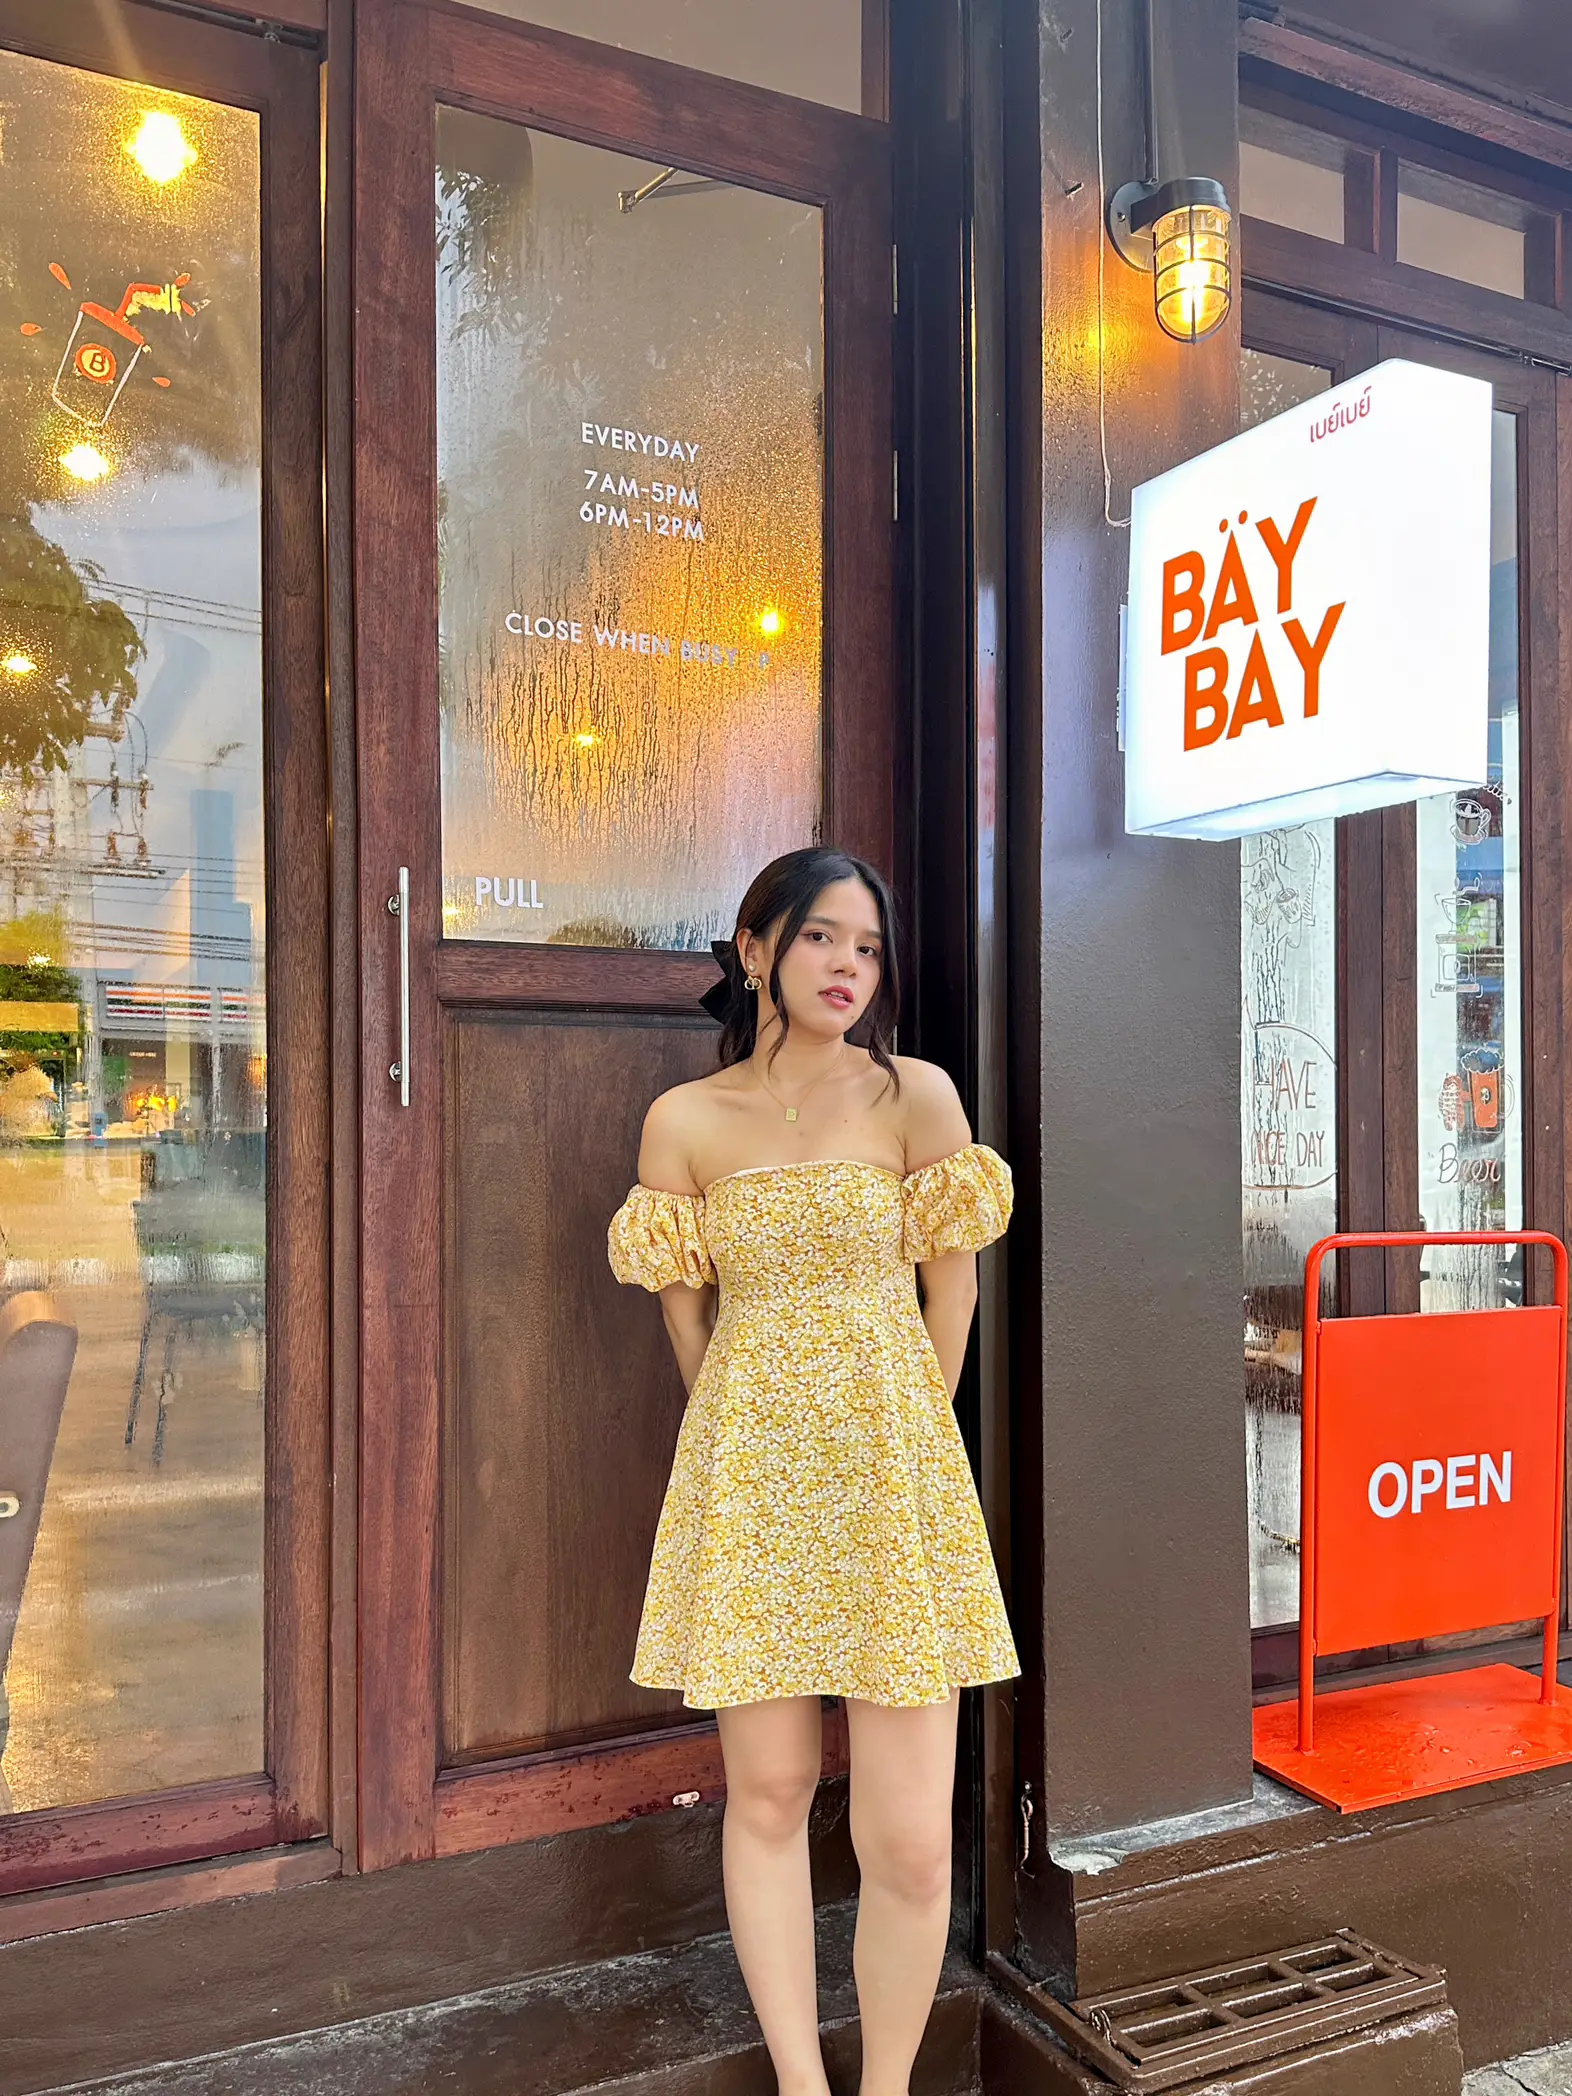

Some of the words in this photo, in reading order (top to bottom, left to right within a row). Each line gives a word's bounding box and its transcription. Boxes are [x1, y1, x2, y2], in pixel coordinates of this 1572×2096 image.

[1310, 385, 1372, 443] เบย์เบย์
[581, 421, 700, 463] EVERYDAY
[583, 469, 699, 510] 7AM-5PM
[579, 501, 704, 542] 6PM-12PM
[1161, 496, 1318, 656] BÄY
[504, 611, 583, 645] CLOSE
[593, 623, 670, 656] WHEN
[681, 640, 738, 668] BUSY
[1182, 601, 1346, 752] BAY
[475, 876, 544, 909] PULL
[1252, 1057, 1317, 1111] HAVE
[1296, 1130, 1325, 1168] DAY
[1367, 1450, 1513, 1519] OPEN
